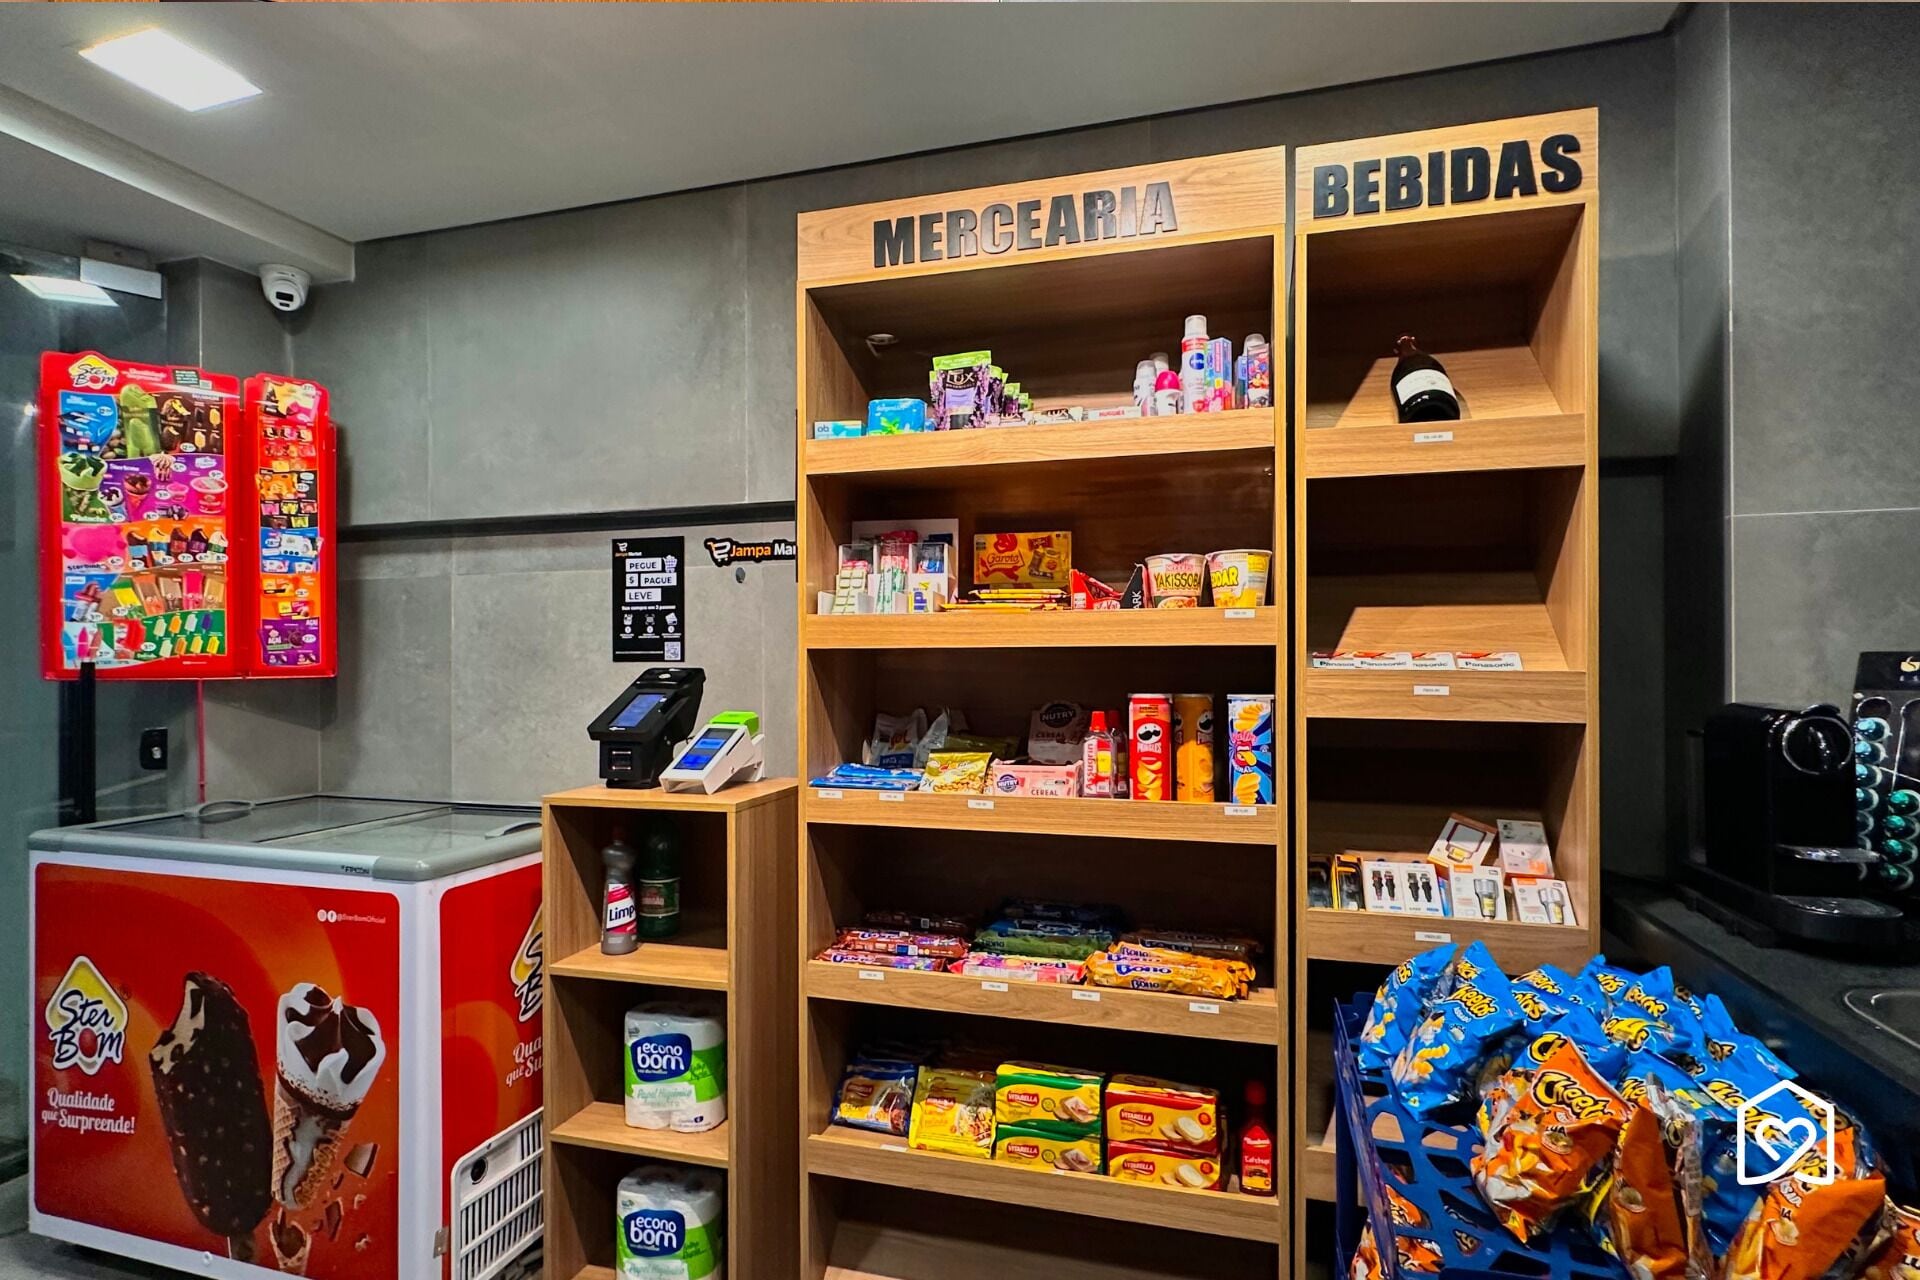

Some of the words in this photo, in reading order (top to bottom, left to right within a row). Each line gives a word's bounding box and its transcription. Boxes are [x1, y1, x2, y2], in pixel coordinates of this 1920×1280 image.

[1312, 134, 1582, 220] BEBIDAS
[873, 181, 1179, 268] MERCEARIA
[947, 370, 975, 385] LUX
[730, 545, 771, 558] Jampa
[987, 553, 1020, 565] Garoto
[629, 562, 657, 570] PEGUE
[644, 576, 672, 584] PAGUE
[628, 591, 652, 600] LEVE
[1132, 590, 1143, 609] ARK
[1042, 710, 1074, 721] NUTRY
[1131, 979, 1160, 989] Bono
[59, 989, 115, 1031] Ster
[642, 1043, 683, 1056] econo
[637, 1046, 685, 1070] bom
[47, 1087, 115, 1112] Qualidade
[1008, 1093, 1038, 1103] VITARELLA
[41, 1110, 58, 1124] que
[59, 1108, 135, 1134] Surpreende!
[1121, 1110, 1152, 1122] VITARELLA
[1008, 1144, 1038, 1154] VITARELLA
[1123, 1161, 1154, 1171] VITARELLA
[636, 1216, 676, 1232] econo
[630, 1220, 677, 1248] bom
